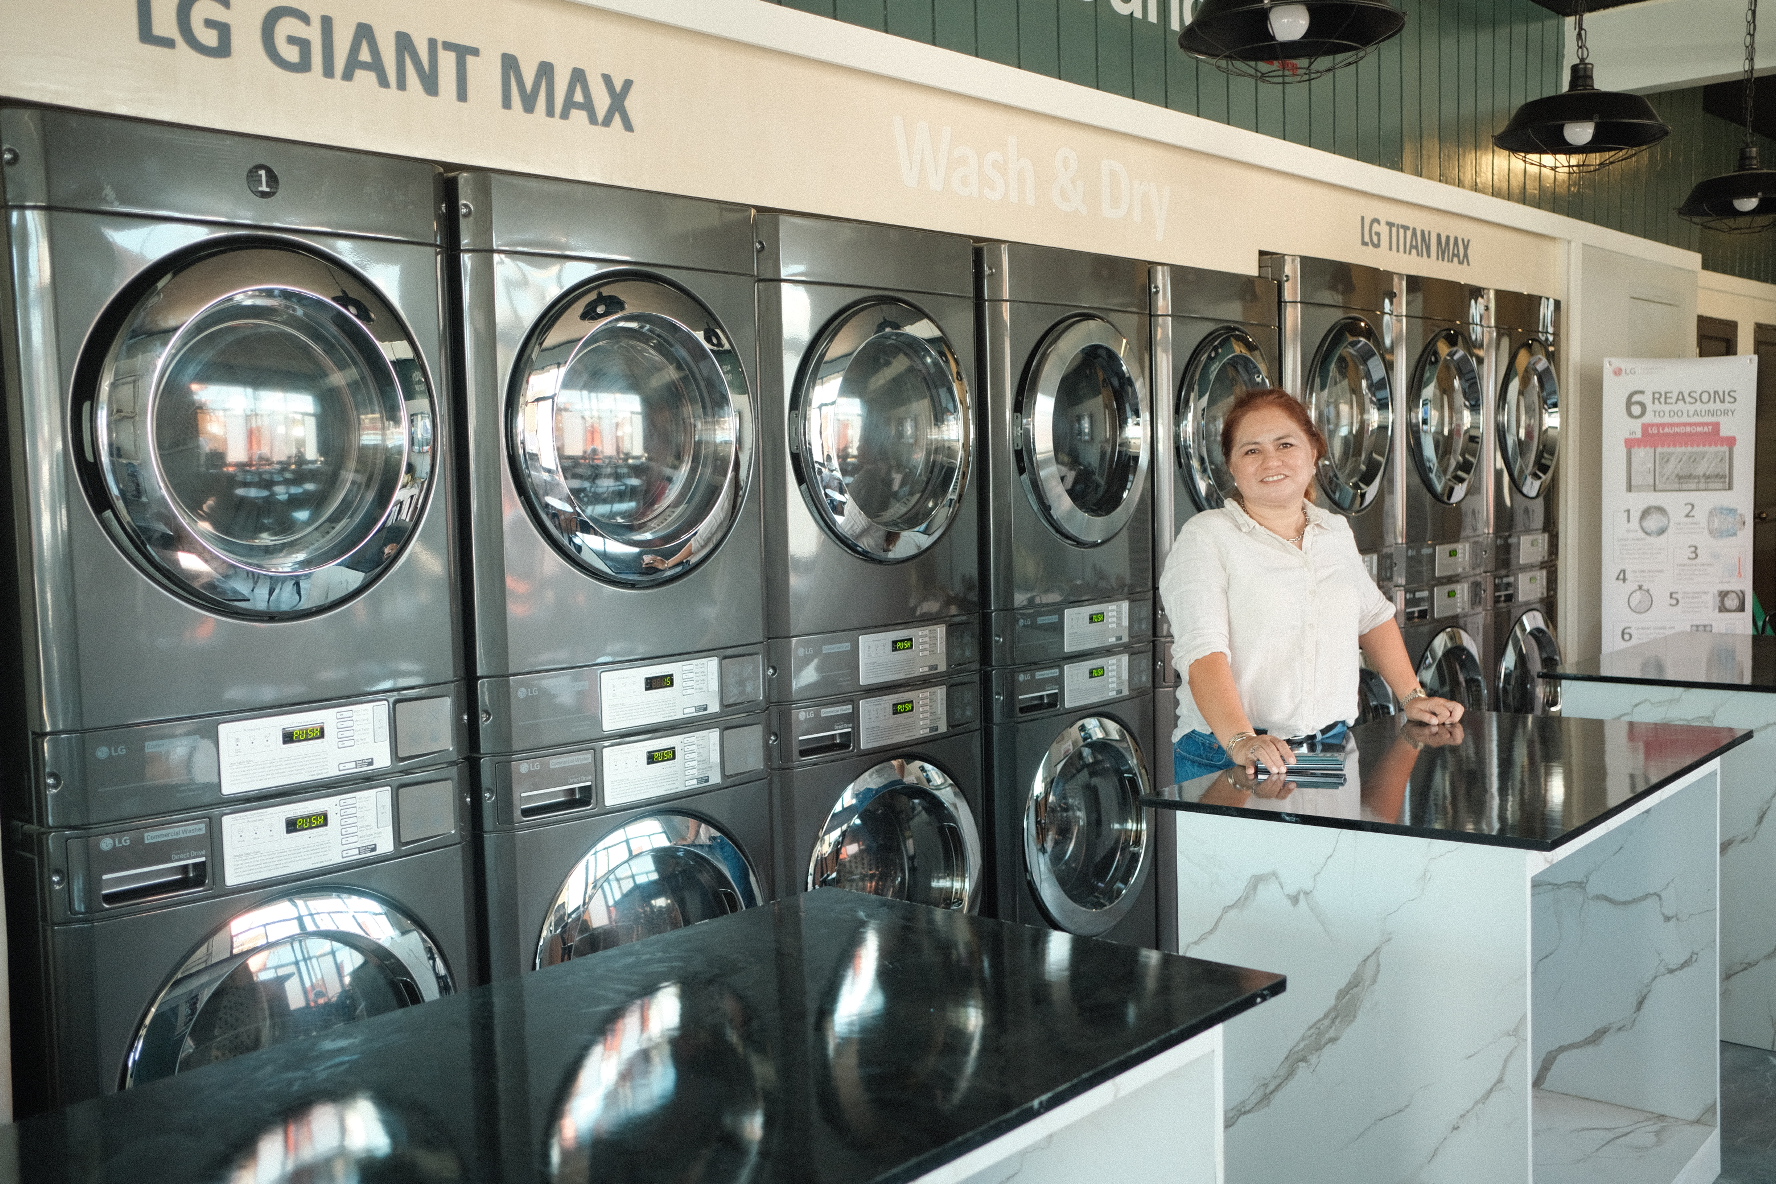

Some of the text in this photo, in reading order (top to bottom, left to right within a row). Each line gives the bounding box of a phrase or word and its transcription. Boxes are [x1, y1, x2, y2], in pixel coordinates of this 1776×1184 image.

[136, 0, 635, 132] LG GIANT MAX
[259, 170, 270, 192] 1
[893, 106, 1171, 241] Wash & Dry
[1361, 216, 1471, 266] LG TITAN MAX
[1624, 368, 1637, 376] LG
[1625, 390, 1738, 420] 6 REASONS
[1652, 408, 1736, 418] TO DO LAUNDRY
[1648, 426, 1658, 434] LG
[1660, 425, 1713, 434] LAUNDROMAT
[1623, 508, 1631, 524] 1
[1684, 502, 1695, 518] 2
[1687, 545, 1699, 560] 3
[1615, 569, 1627, 584] 4
[1669, 591, 1679, 607] 5
[1621, 626, 1632, 642] 6
[528, 688, 538, 696] LG
[293, 727, 320, 740] PUSH
[111, 746, 126, 756] LG
[653, 750, 673, 761] PUSH
[530, 762, 540, 770] LG
[297, 815, 325, 829] PUSH
[115, 836, 130, 847] LG
